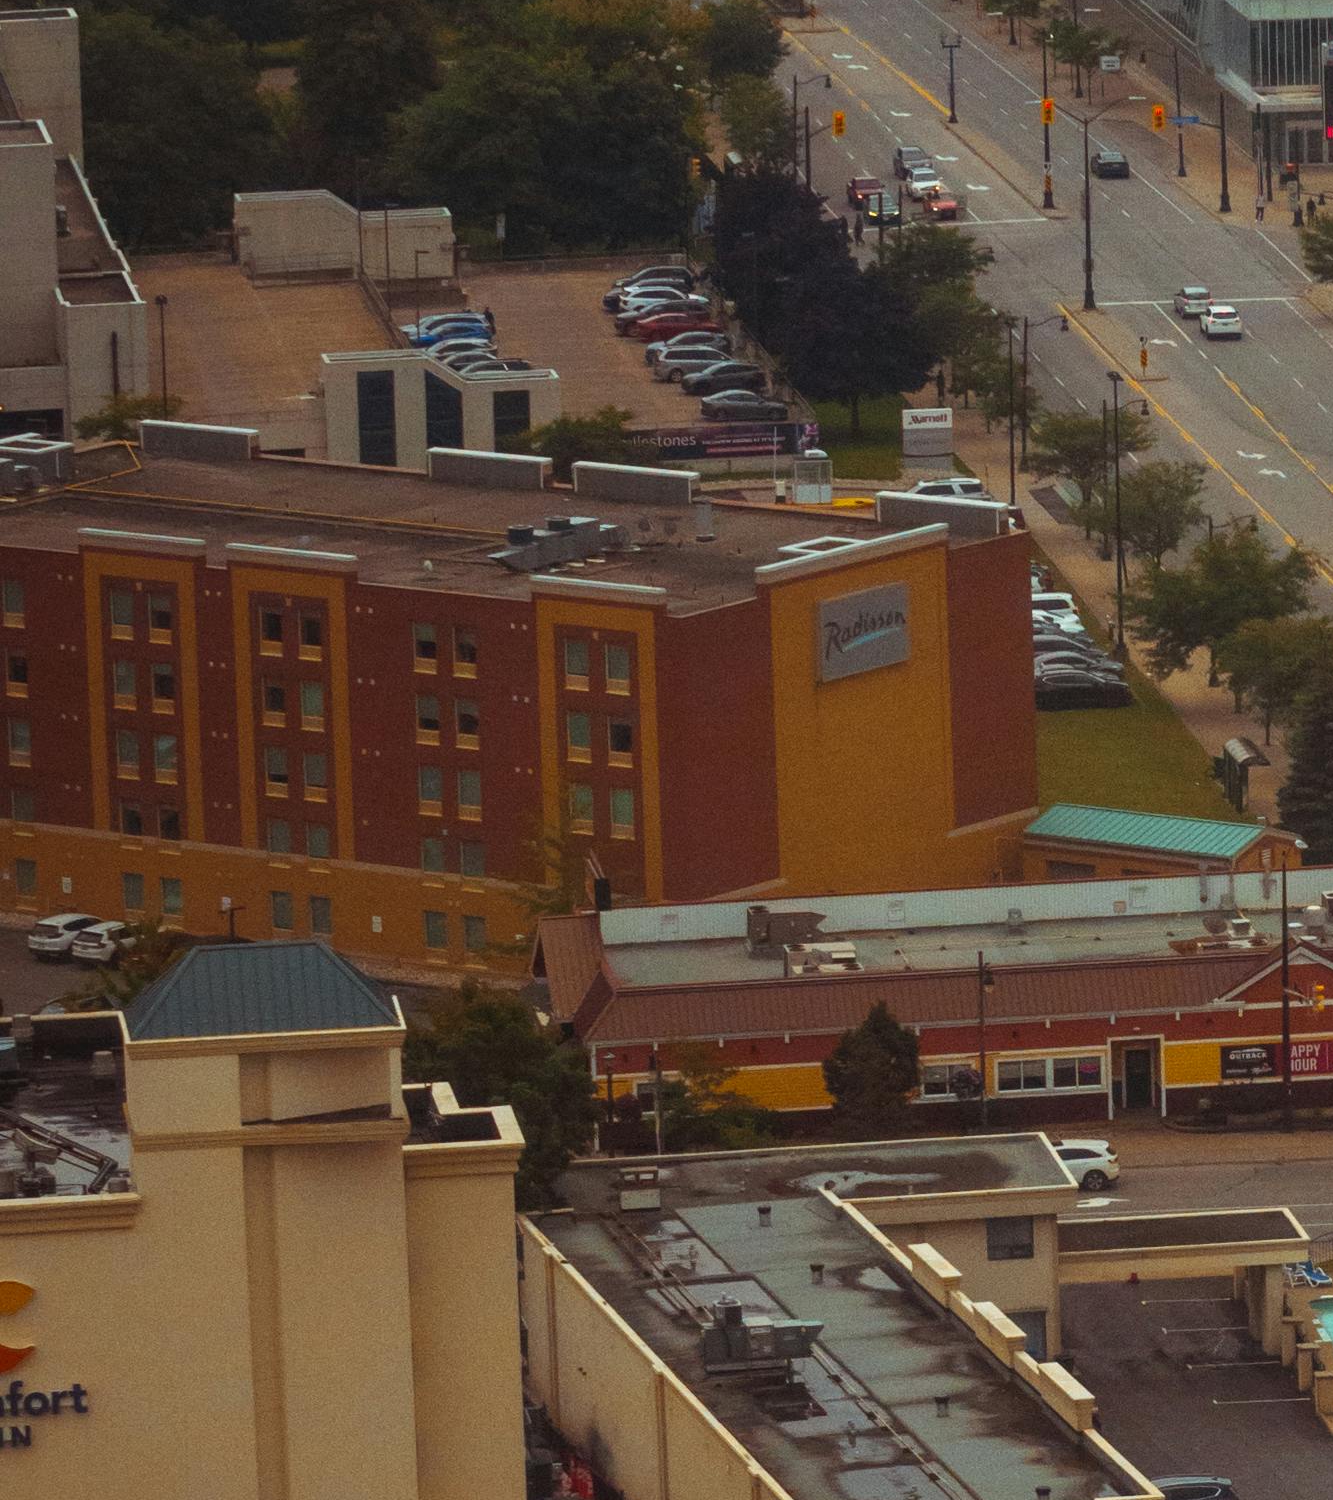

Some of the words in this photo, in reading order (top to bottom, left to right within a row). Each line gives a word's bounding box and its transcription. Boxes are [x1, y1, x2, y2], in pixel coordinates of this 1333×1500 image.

[908, 413, 948, 425] Marriott
[823, 611, 906, 660] Radisson
[1229, 1052, 1268, 1060] OUTBACK
[1286, 1043, 1321, 1058] APPY
